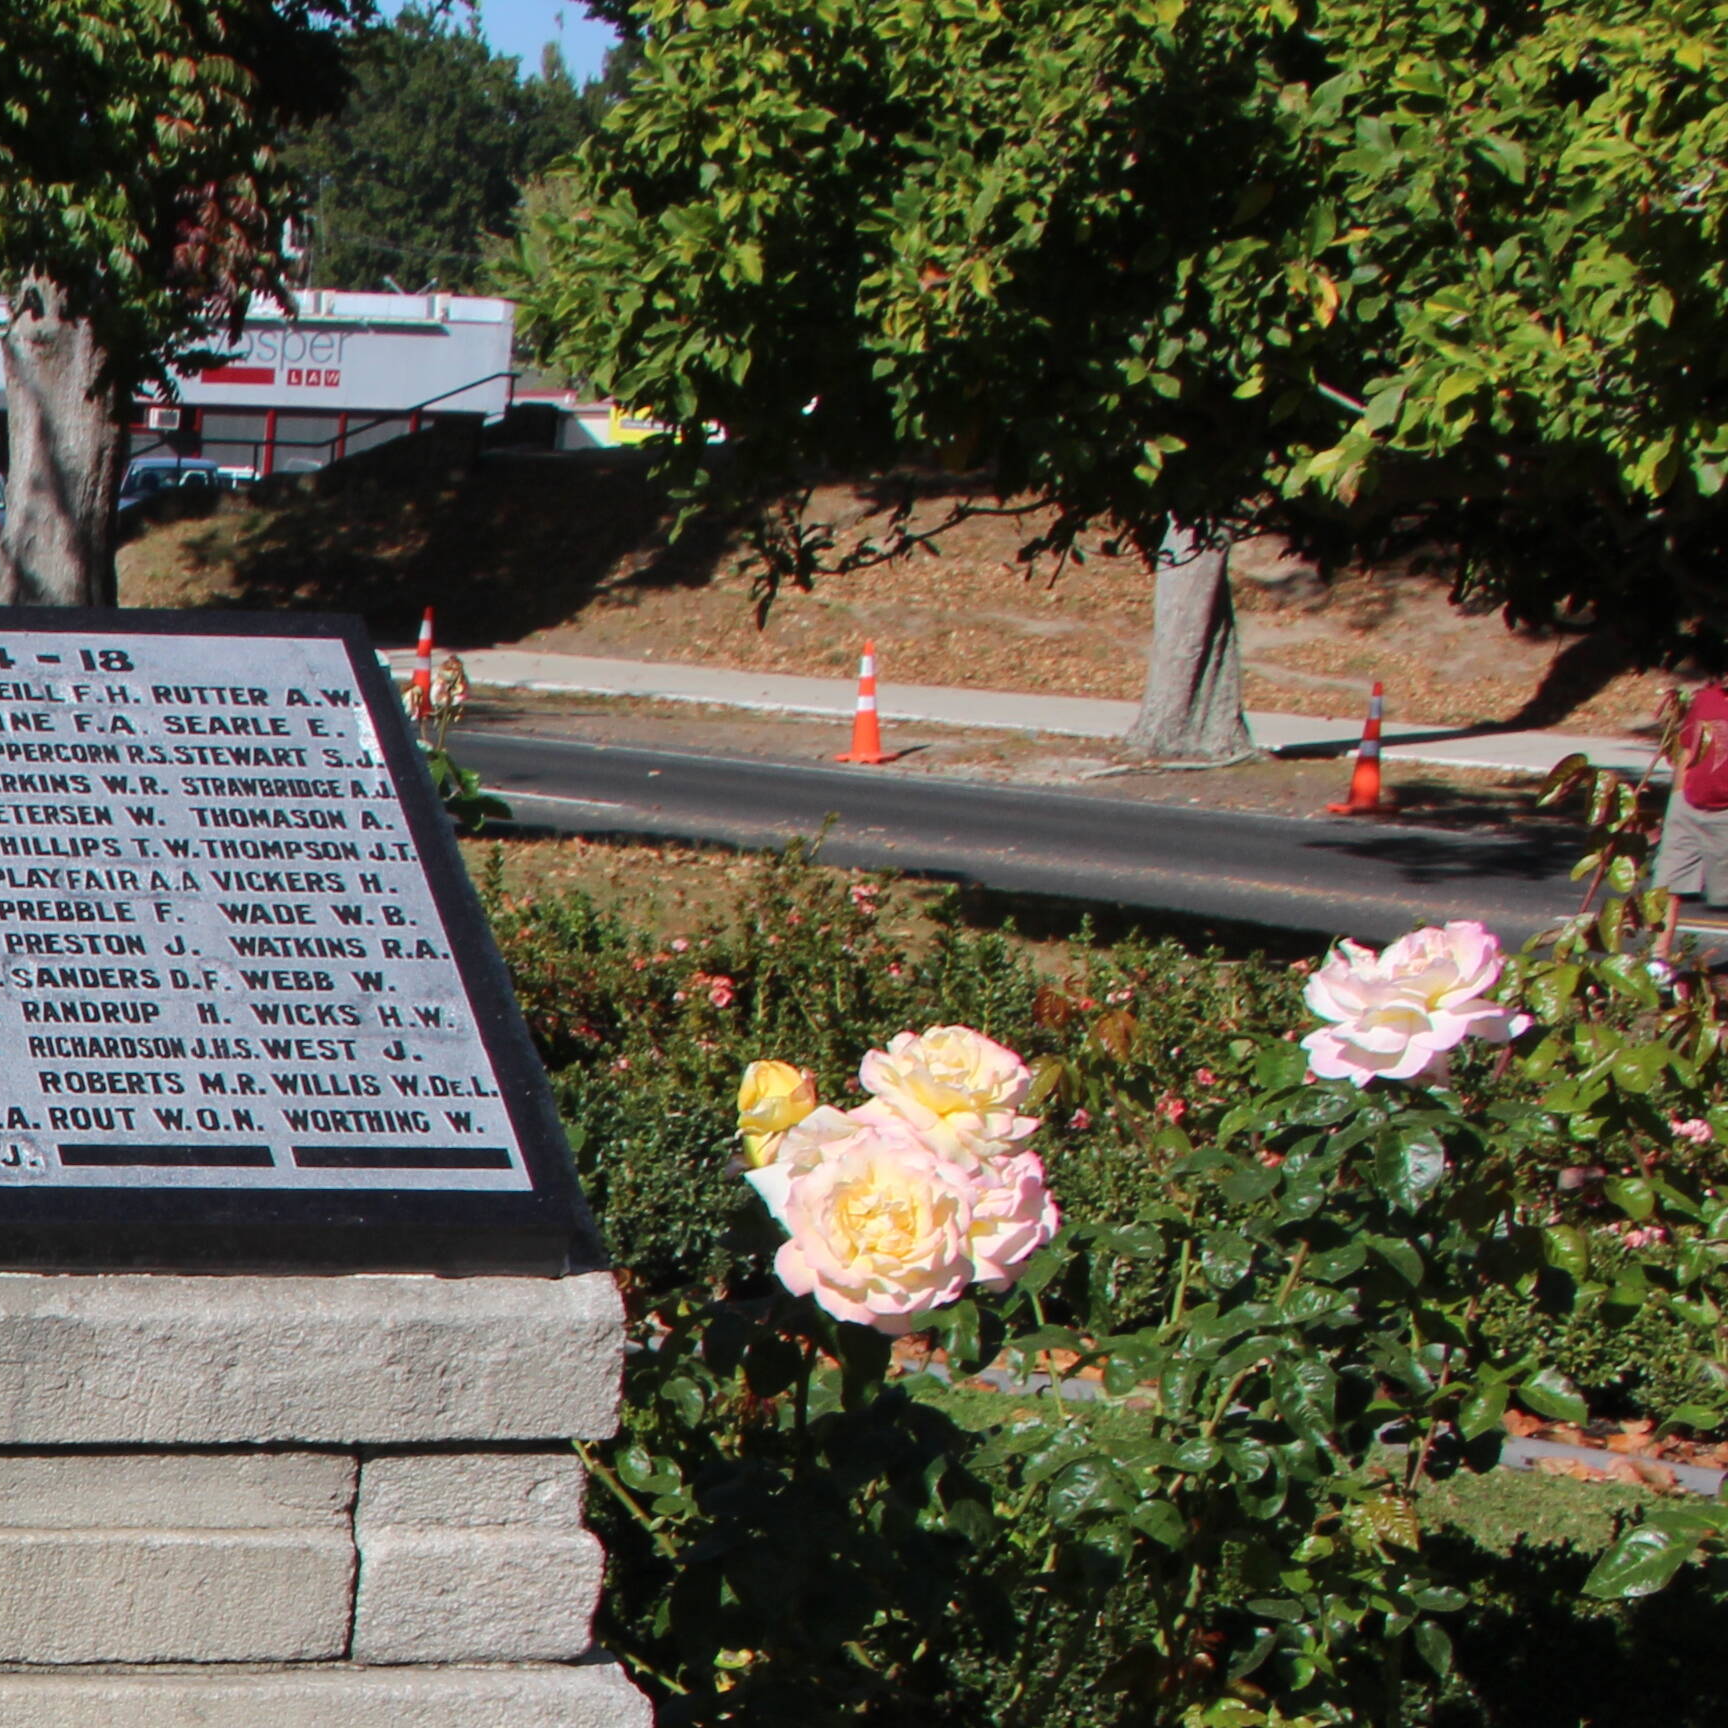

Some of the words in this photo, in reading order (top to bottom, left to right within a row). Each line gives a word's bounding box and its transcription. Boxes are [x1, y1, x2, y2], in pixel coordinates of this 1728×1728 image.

[290, 371, 340, 385] LAW
[152, 686, 269, 706] RUTTER
[164, 716, 290, 736] SEARLE
[183, 777, 340, 798] STRAWBRIDGE
[190, 807, 347, 830] THOMASON
[361, 811, 394, 830] A.
[210, 871, 345, 894] VICKERS
[359, 873, 397, 894] H.
[229, 936, 366, 959] WATKINS
[240, 970, 334, 991] WEBB
[352, 971, 396, 992] W.
[29, 1036, 186, 1060] RICHARDSON
[261, 1040, 357, 1060] WEST
[383, 1041, 422, 1061] J.
[281, 1109, 431, 1133] WORTHING
[443, 1111, 484, 1134] W.
